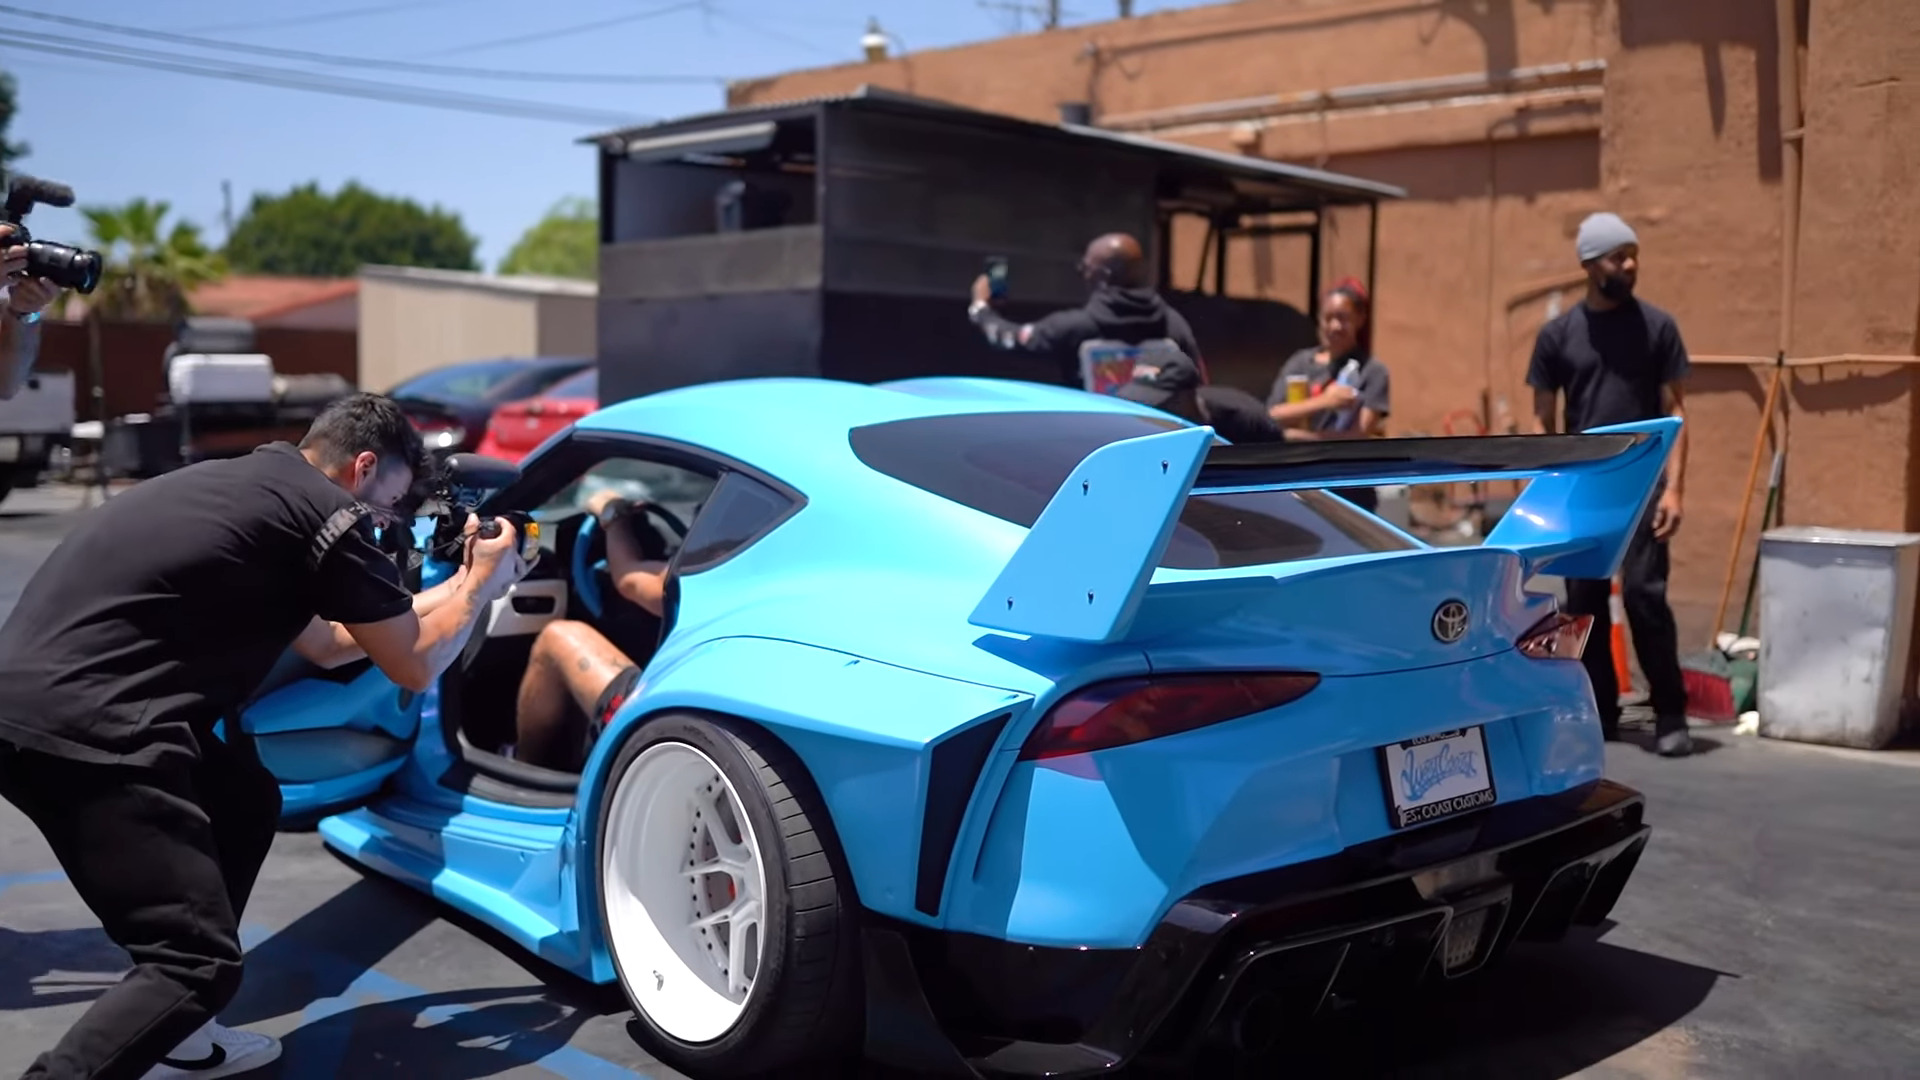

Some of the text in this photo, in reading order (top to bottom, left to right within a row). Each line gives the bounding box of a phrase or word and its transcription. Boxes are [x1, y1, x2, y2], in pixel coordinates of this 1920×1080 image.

[1400, 789, 1494, 825] EST COAST CUSTOMS
